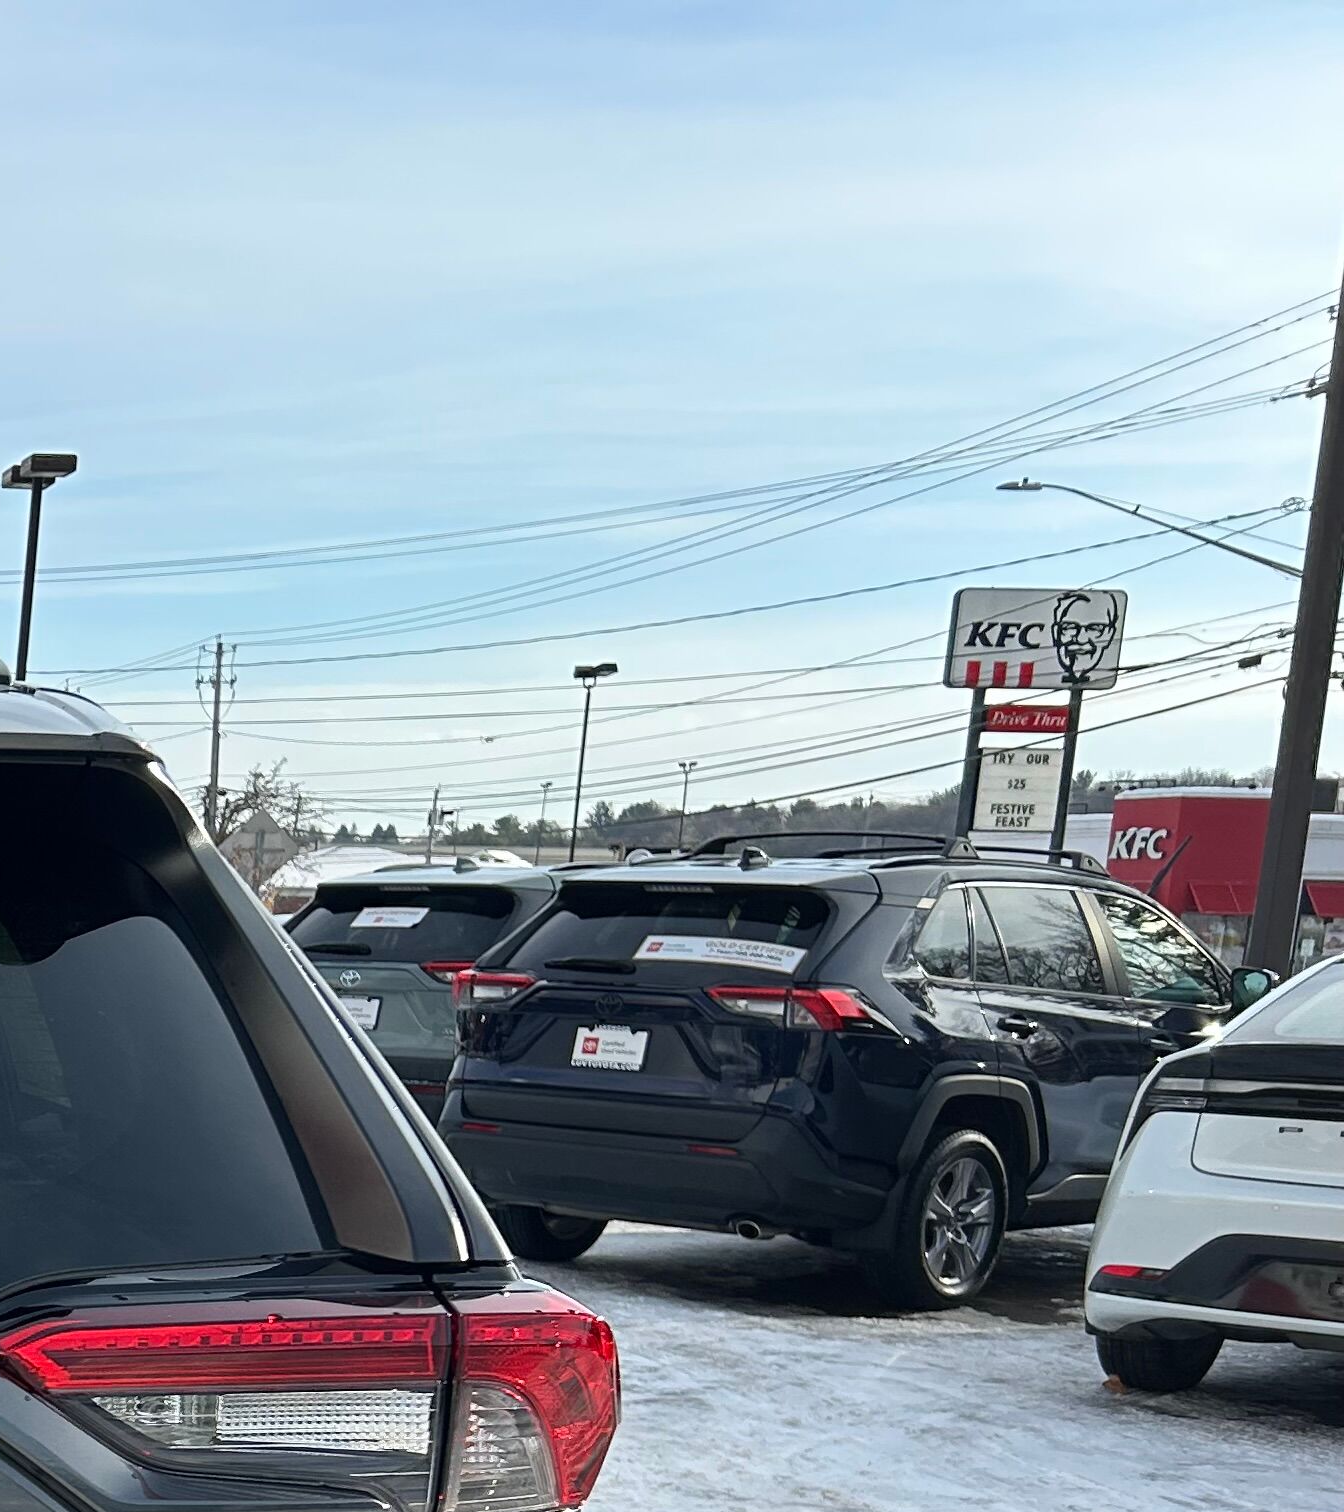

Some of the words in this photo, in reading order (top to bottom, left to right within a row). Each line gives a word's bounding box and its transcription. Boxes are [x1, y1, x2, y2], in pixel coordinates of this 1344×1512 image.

[965, 621, 1045, 649] KFC
[991, 710, 1029, 726] Drive
[1032, 711, 1066, 727] Thru
[992, 753, 1016, 765] TRY
[1026, 753, 1050, 765] OUR
[1007, 778, 1026, 790] $25
[990, 803, 1036, 815] FESTIVE
[994, 816, 1031, 827] FEAST
[1108, 827, 1168, 860] KFC
